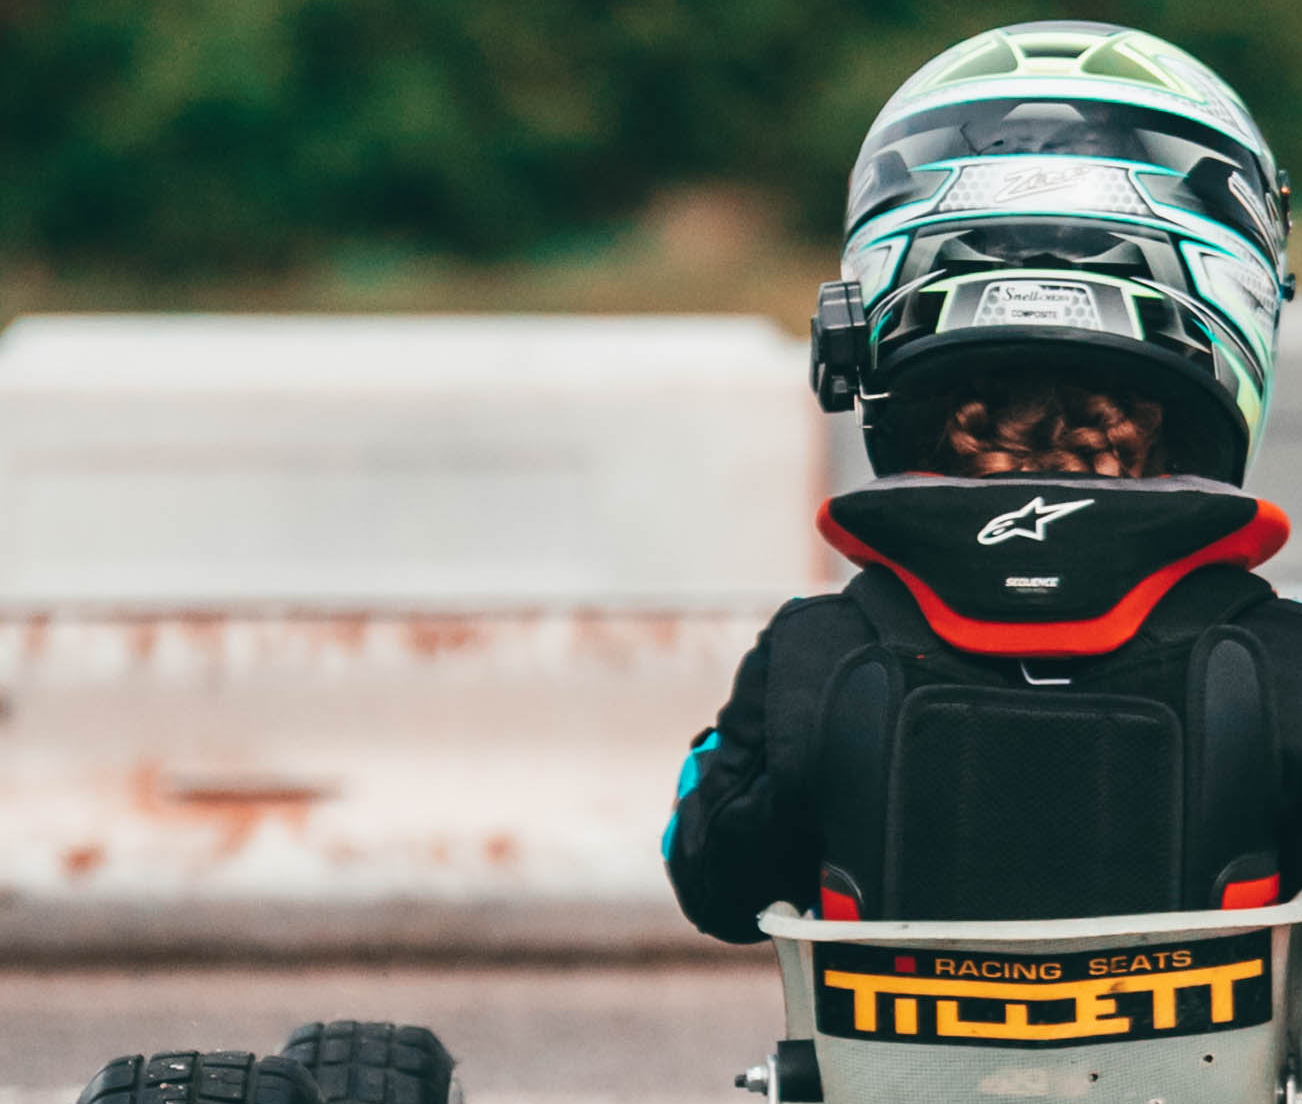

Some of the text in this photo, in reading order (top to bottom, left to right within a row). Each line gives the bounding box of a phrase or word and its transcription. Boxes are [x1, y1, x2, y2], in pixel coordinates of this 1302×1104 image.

[934, 950, 1193, 981] RACING SEATS
[823, 958, 1264, 1040] TILLETT
